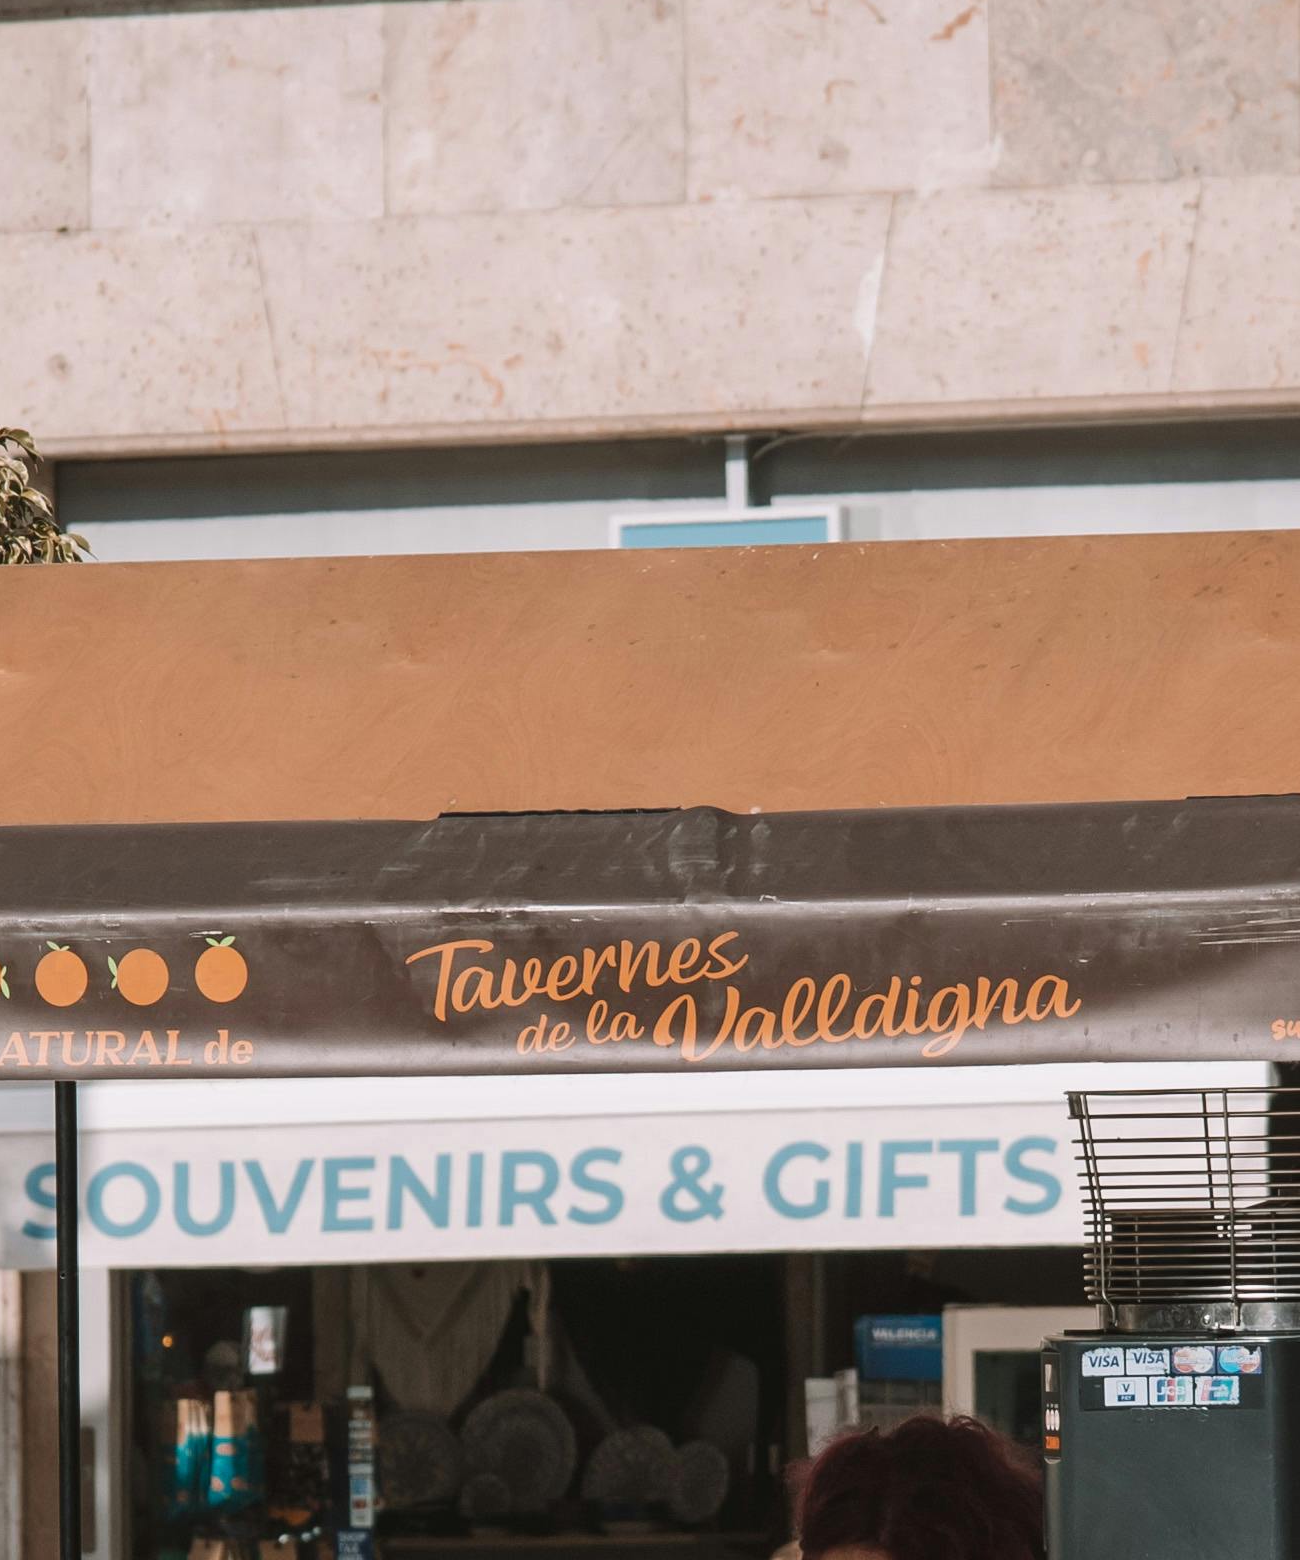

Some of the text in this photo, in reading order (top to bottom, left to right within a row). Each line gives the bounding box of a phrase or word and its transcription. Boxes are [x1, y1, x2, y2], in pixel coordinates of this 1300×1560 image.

[406, 930, 749, 1022] Tavernes
[203, 1028, 255, 1066] de
[516, 972, 1082, 1062] de la Valldigna
[21, 1135, 1064, 1242] SOUVENIRS & GIFTS
[1089, 1355, 1120, 1368] VISA
[1132, 1352, 1165, 1364] VISA
[1122, 1383, 1130, 1393] V
